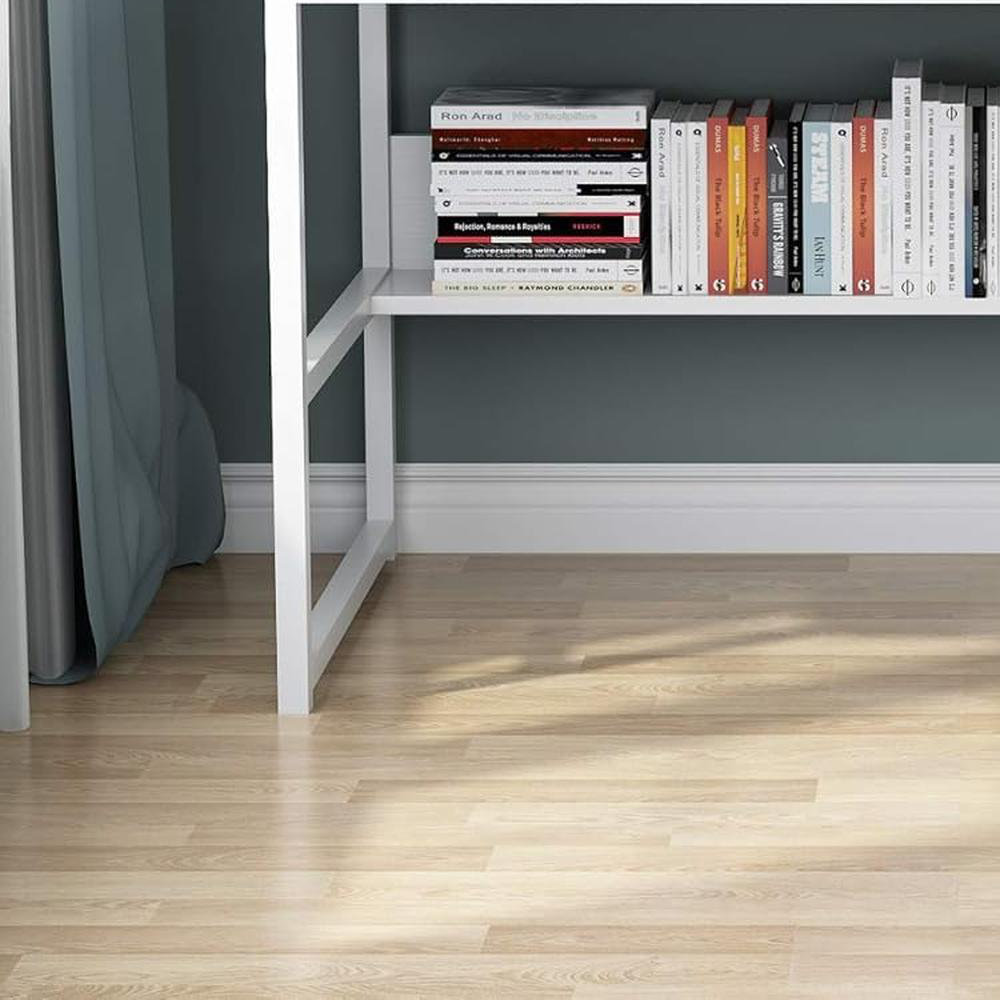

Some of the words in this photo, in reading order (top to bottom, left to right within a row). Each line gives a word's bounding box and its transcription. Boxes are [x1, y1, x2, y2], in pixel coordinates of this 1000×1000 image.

[440, 112, 468, 121] Ron
[471, 112, 503, 121] Arad
[658, 127, 666, 149] Ron
[714, 125, 722, 153] DUMAS
[881, 127, 889, 150] Ron
[658, 152, 666, 178] Arad
[810, 131, 830, 203] STEAM
[881, 152, 889, 178] Arad
[714, 177, 722, 192] The
[752, 177, 760, 191] The
[859, 177, 867, 192] The
[714, 195, 722, 215] Black
[752, 195, 760, 214] Black
[859, 194, 867, 216] Black
[454, 222, 486, 231] Rejection,
[486, 222, 516, 231] Romance
[522, 222, 551, 231] Royalties
[714, 217, 722, 238] Tulip
[752, 217, 760, 237] Tulip
[772, 202, 784, 240] GRAVITY'S
[859, 217, 867, 239] Tulip
[814, 236, 826, 252] IAN
[772, 241, 784, 278] RAINBOW
[814, 253, 826, 278] HUNT
